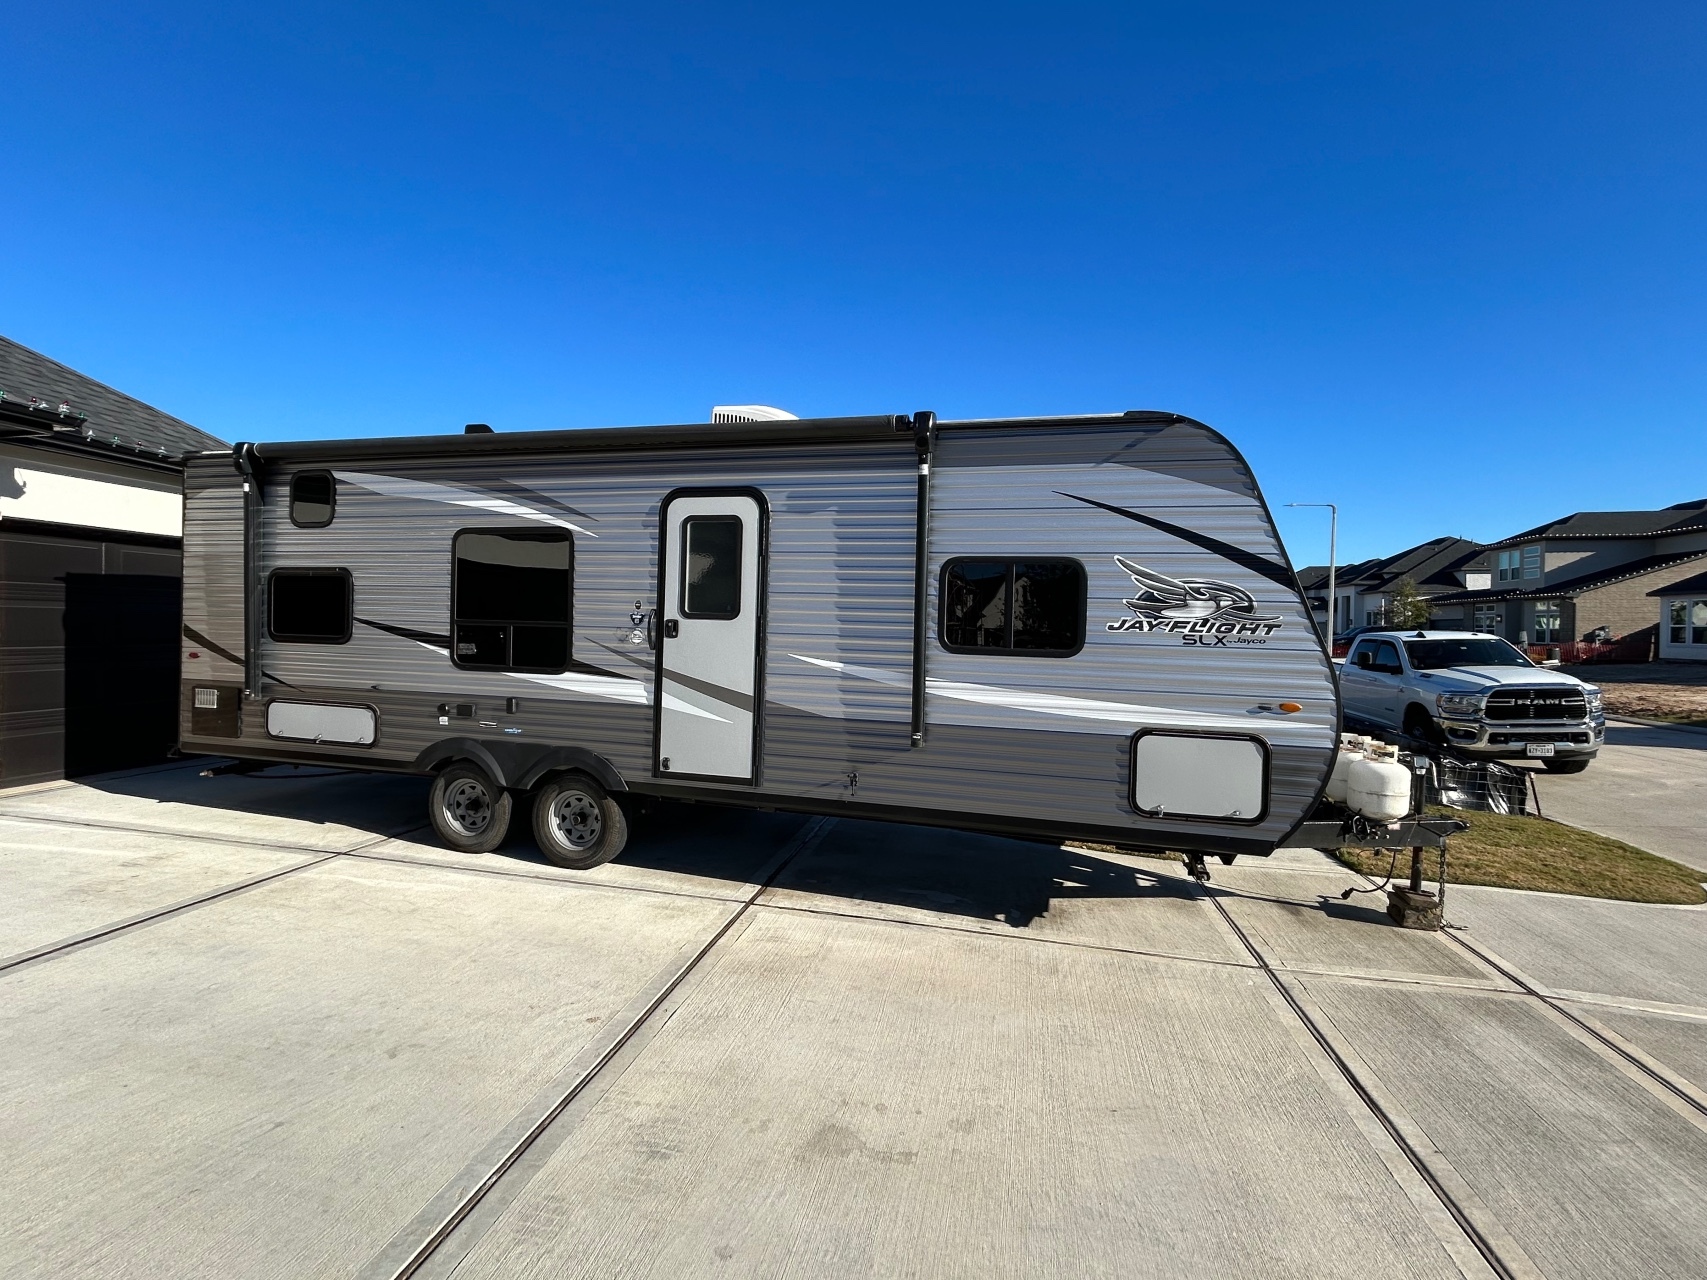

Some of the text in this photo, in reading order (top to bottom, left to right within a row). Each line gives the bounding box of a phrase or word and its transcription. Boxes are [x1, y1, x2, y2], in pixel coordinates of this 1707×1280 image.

[1107, 618, 1282, 635] JAY FLIGHT
[1182, 634, 1228, 646] SLX
[1234, 636, 1266, 645] Jayco
